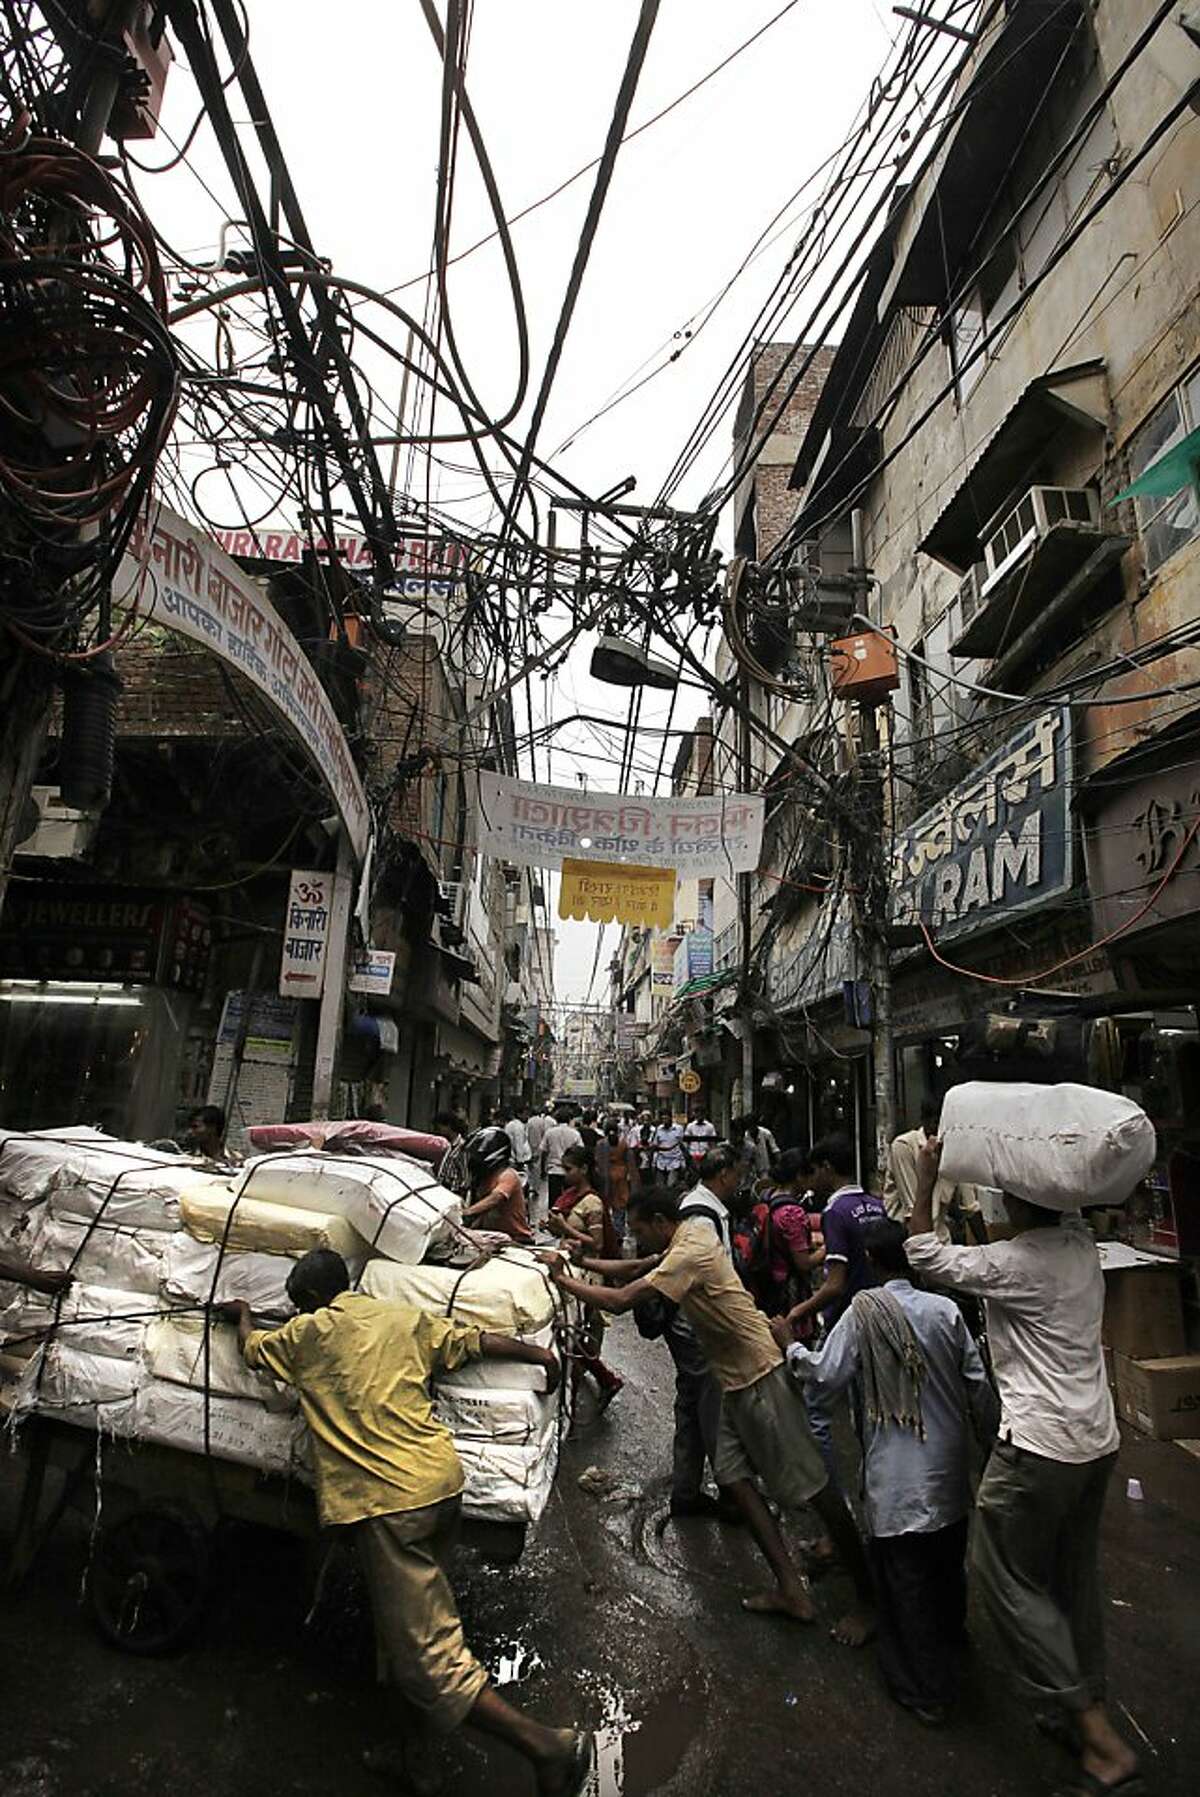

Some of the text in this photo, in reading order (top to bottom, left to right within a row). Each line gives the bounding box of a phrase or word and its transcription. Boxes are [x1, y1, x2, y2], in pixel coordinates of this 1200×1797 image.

[161, 586, 223, 643] आपका
[931, 809, 1041, 926] RAM
[289, 902, 327, 930] किनारी
[286, 937, 324, 961] बाजार
